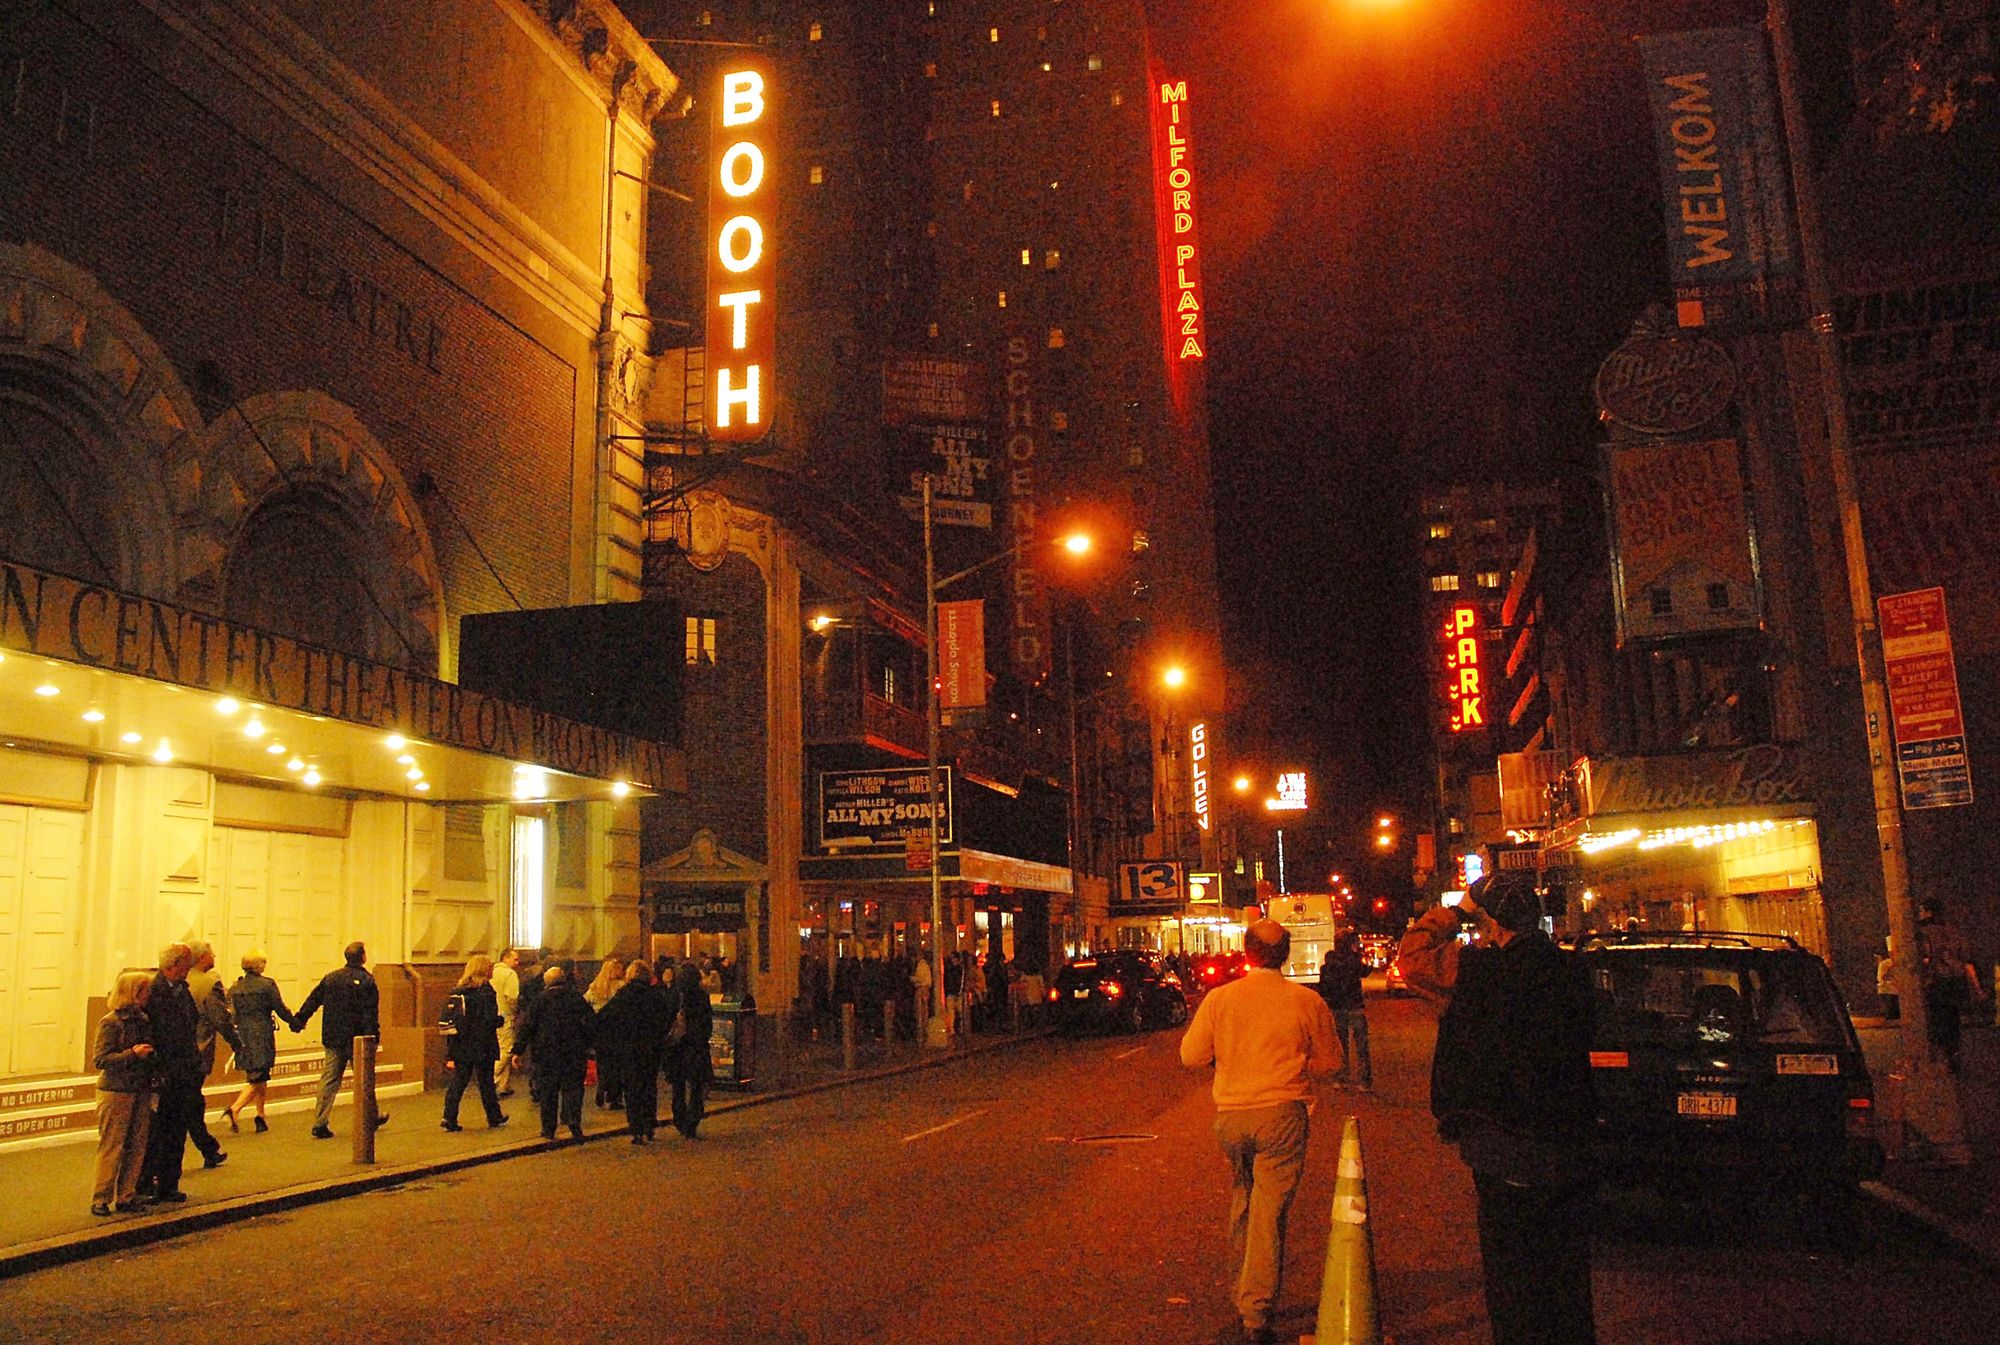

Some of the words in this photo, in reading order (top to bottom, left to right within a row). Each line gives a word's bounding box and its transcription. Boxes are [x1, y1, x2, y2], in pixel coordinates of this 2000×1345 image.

[1161, 81, 1193, 233] MILFORD
[1664, 71, 1733, 269] WELKOM
[716, 69, 765, 428] BOOTH
[1176, 245, 1203, 359] PLAZA
[931, 436, 972, 456] ALL
[946, 456, 991, 480] MY
[910, 471, 975, 497] SONS
[68, 585, 279, 703] CENTER
[296, 640, 465, 750] THEATER
[1455, 608, 1483, 725] PARK
[1914, 744, 1933, 755] Pay
[826, 808, 859, 823] ALL
[858, 807, 895, 827] MY
[894, 802, 946, 820] SONS
[856, 797, 896, 808] MILLER'S
[1127, 863, 1177, 898] 13
[1, 1095, 16, 1106] NO
[18, 1088, 74, 1105] LOITERING
[16, 1118, 45, 1133] OPEN
[46, 1116, 68, 1129] OUT
